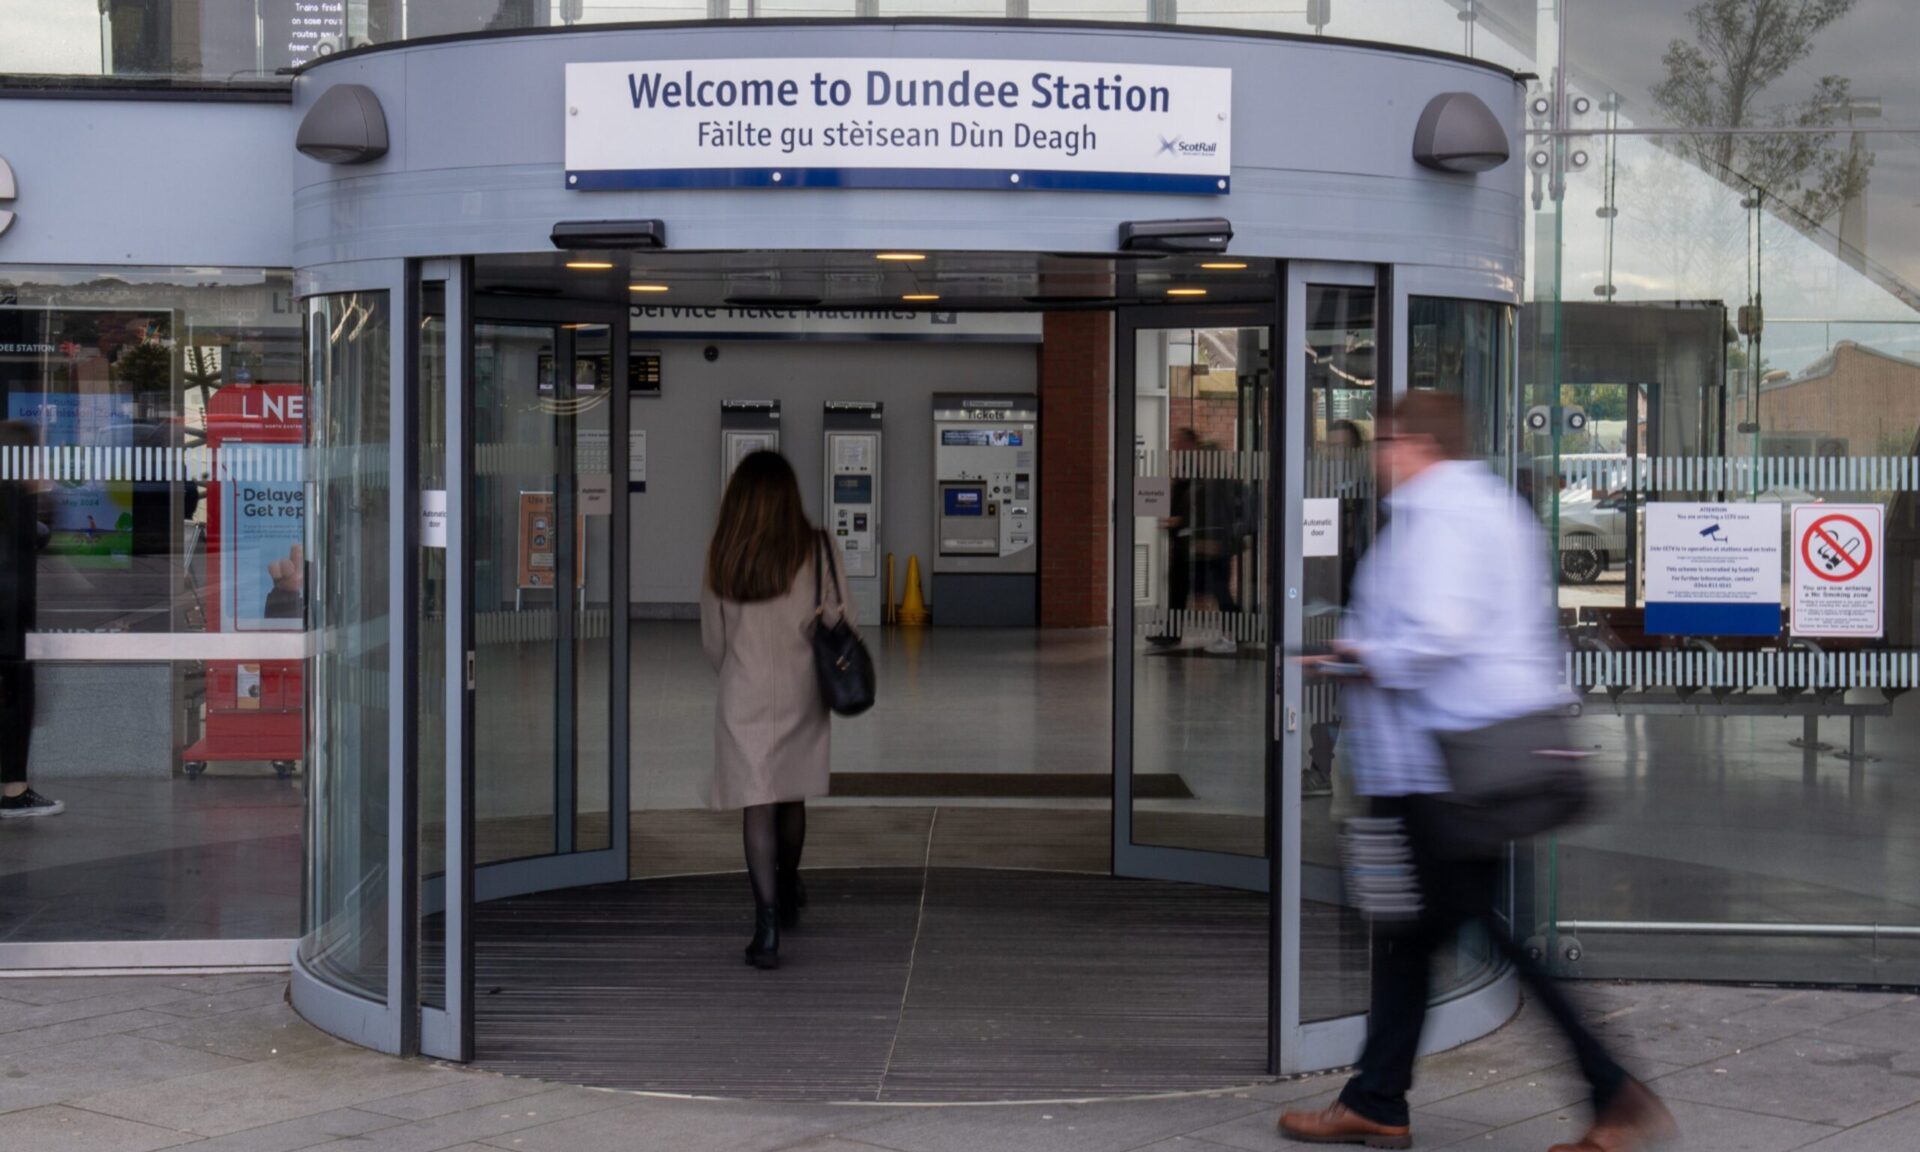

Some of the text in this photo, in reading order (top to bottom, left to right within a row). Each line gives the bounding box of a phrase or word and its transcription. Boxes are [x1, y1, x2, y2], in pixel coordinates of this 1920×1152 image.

[295, 2, 319, 12] Trains
[628, 70, 1170, 113] Welcome to Dundee Station
[699, 120, 1096, 156] Fàilte gu stèisean Dùn Deagh
[1178, 141, 1217, 153] ScotRail
[16, 343, 55, 352] STATION
[966, 408, 1005, 420] Tickets
[1137, 489, 1165, 497] Automatic
[244, 503, 274, 517] Get
[1303, 518, 1332, 527] Automatic
